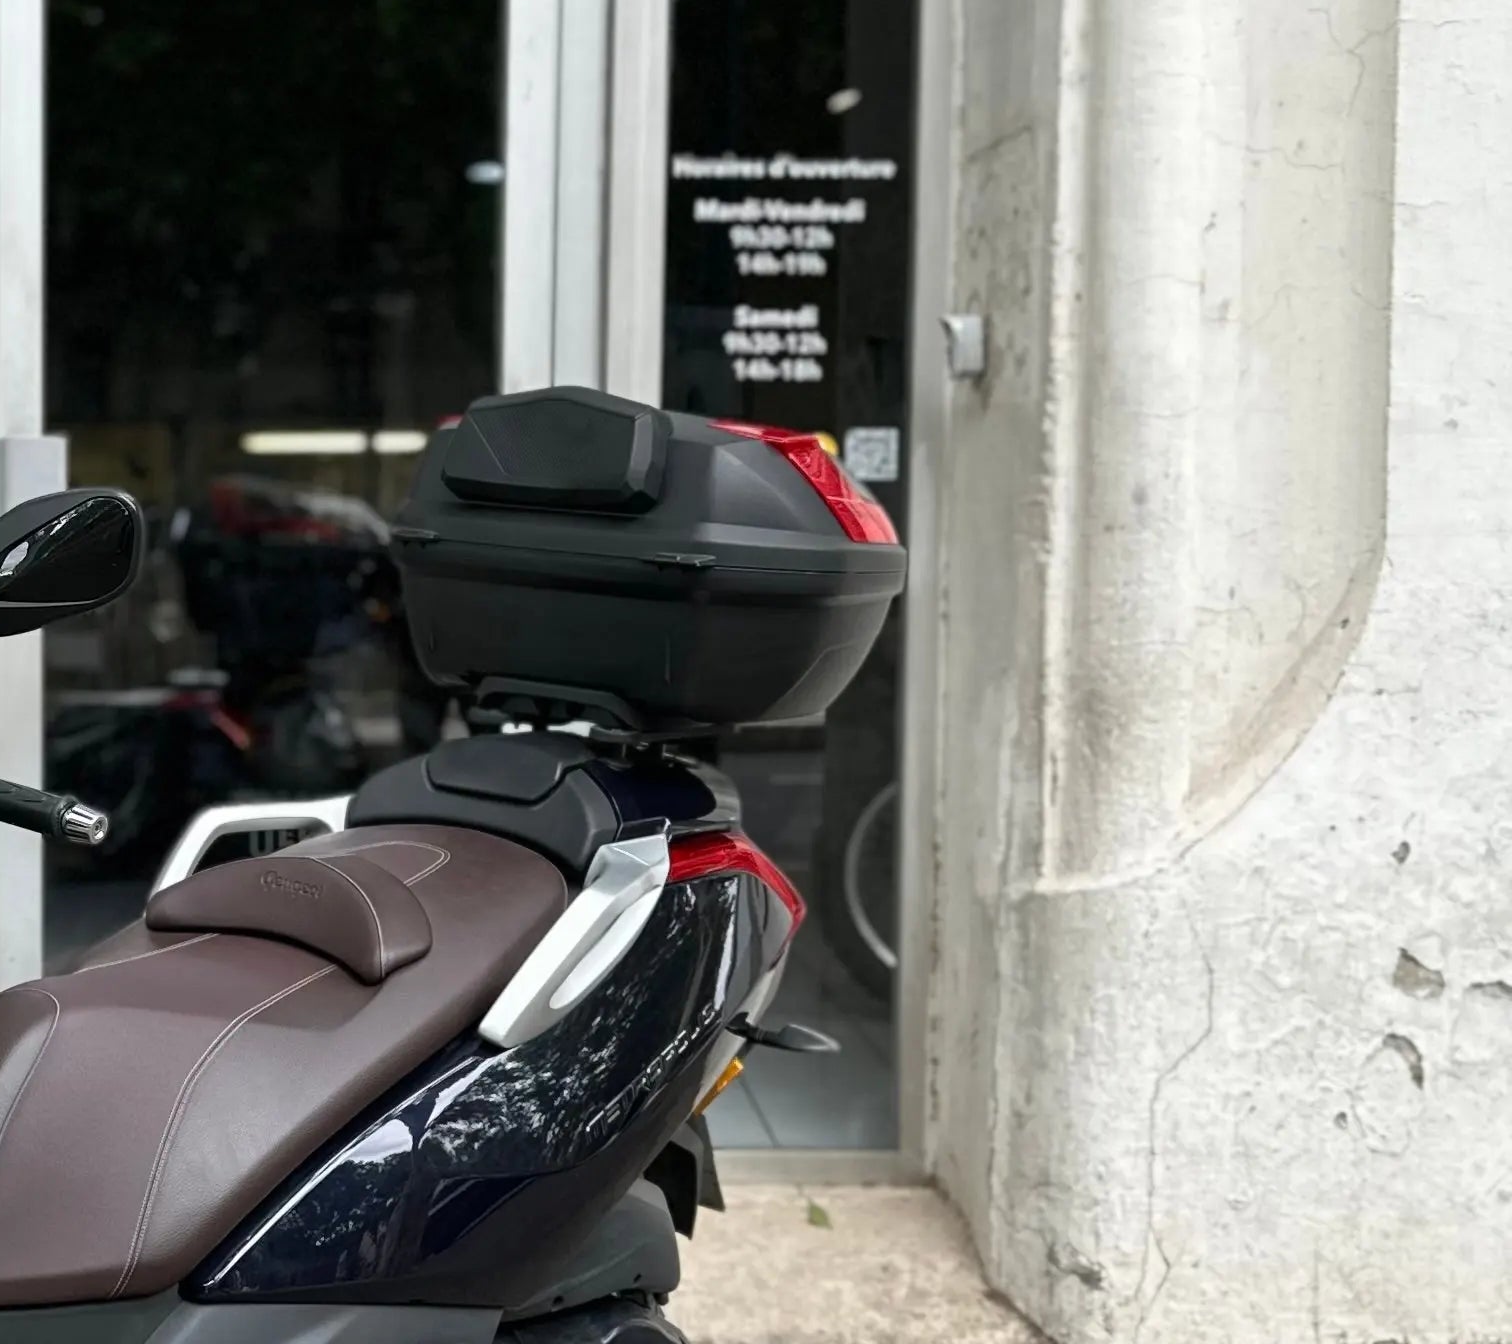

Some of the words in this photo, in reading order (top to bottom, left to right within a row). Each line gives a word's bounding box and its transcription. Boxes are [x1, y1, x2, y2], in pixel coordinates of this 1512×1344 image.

[672, 155, 766, 179] Horaires
[768, 155, 897, 180] d'ouverture
[733, 304, 819, 329] Samedi
